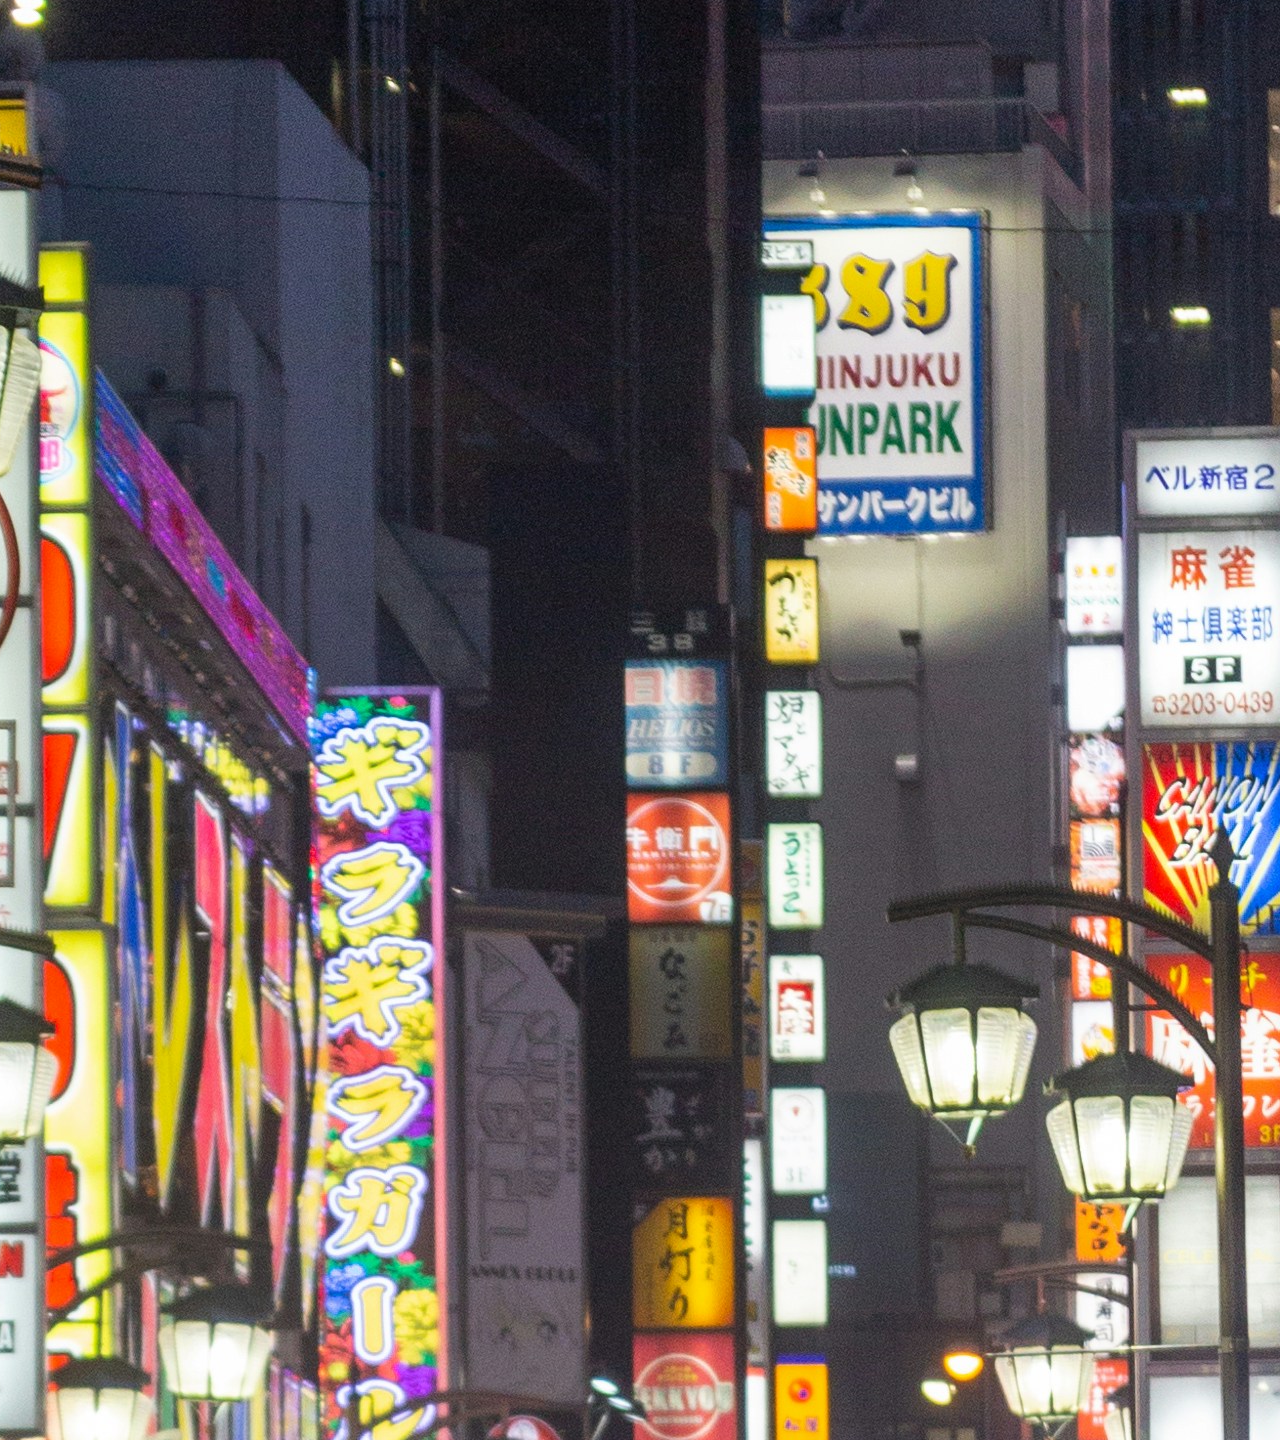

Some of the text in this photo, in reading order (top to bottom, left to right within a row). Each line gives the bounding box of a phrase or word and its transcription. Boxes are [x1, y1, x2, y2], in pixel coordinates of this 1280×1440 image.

[804, 400, 963, 457] UNPARK
[1170, 545, 1257, 591] 麻雀
[1152, 607, 1274, 645] 紳士倶楽部
[1189, 658, 1237, 683] 5F
[1168, 690, 1274, 716] 3203-0439
